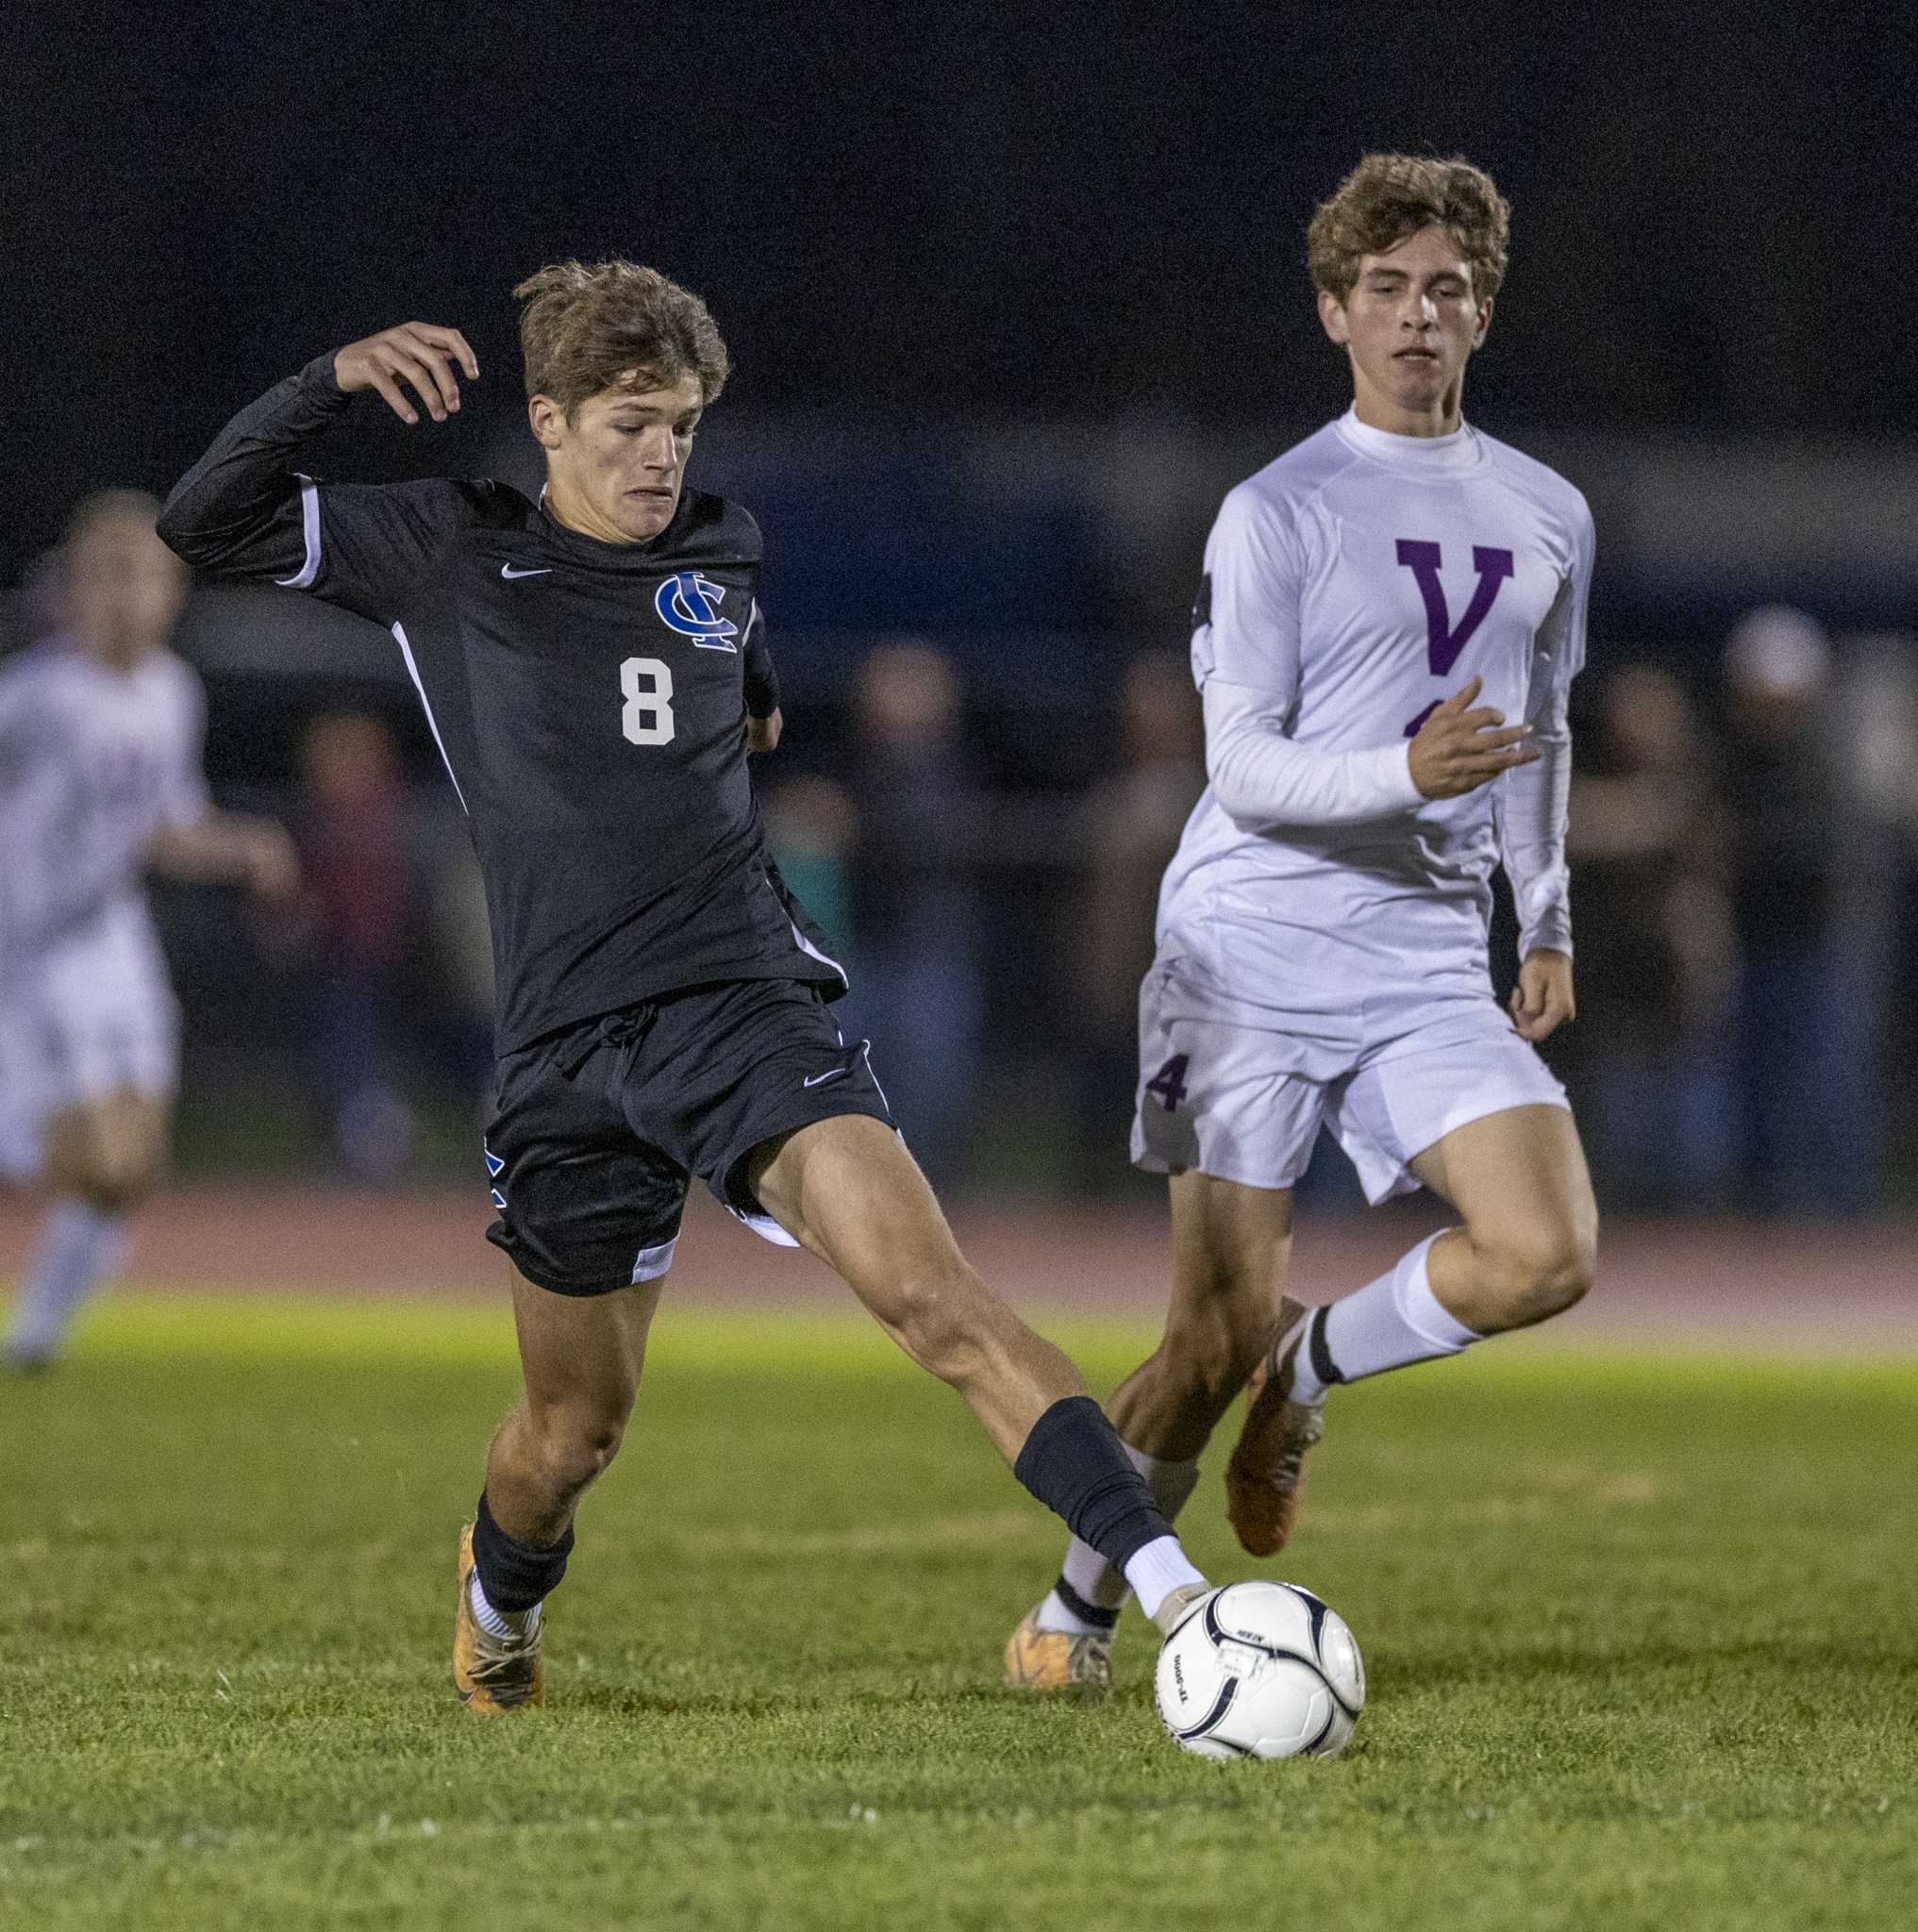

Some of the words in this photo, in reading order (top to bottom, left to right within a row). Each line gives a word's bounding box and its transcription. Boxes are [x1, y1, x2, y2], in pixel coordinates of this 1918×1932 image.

[1394, 538, 1514, 677] V
[620, 657, 675, 745] 8
[1146, 1055, 1190, 1113] 4
